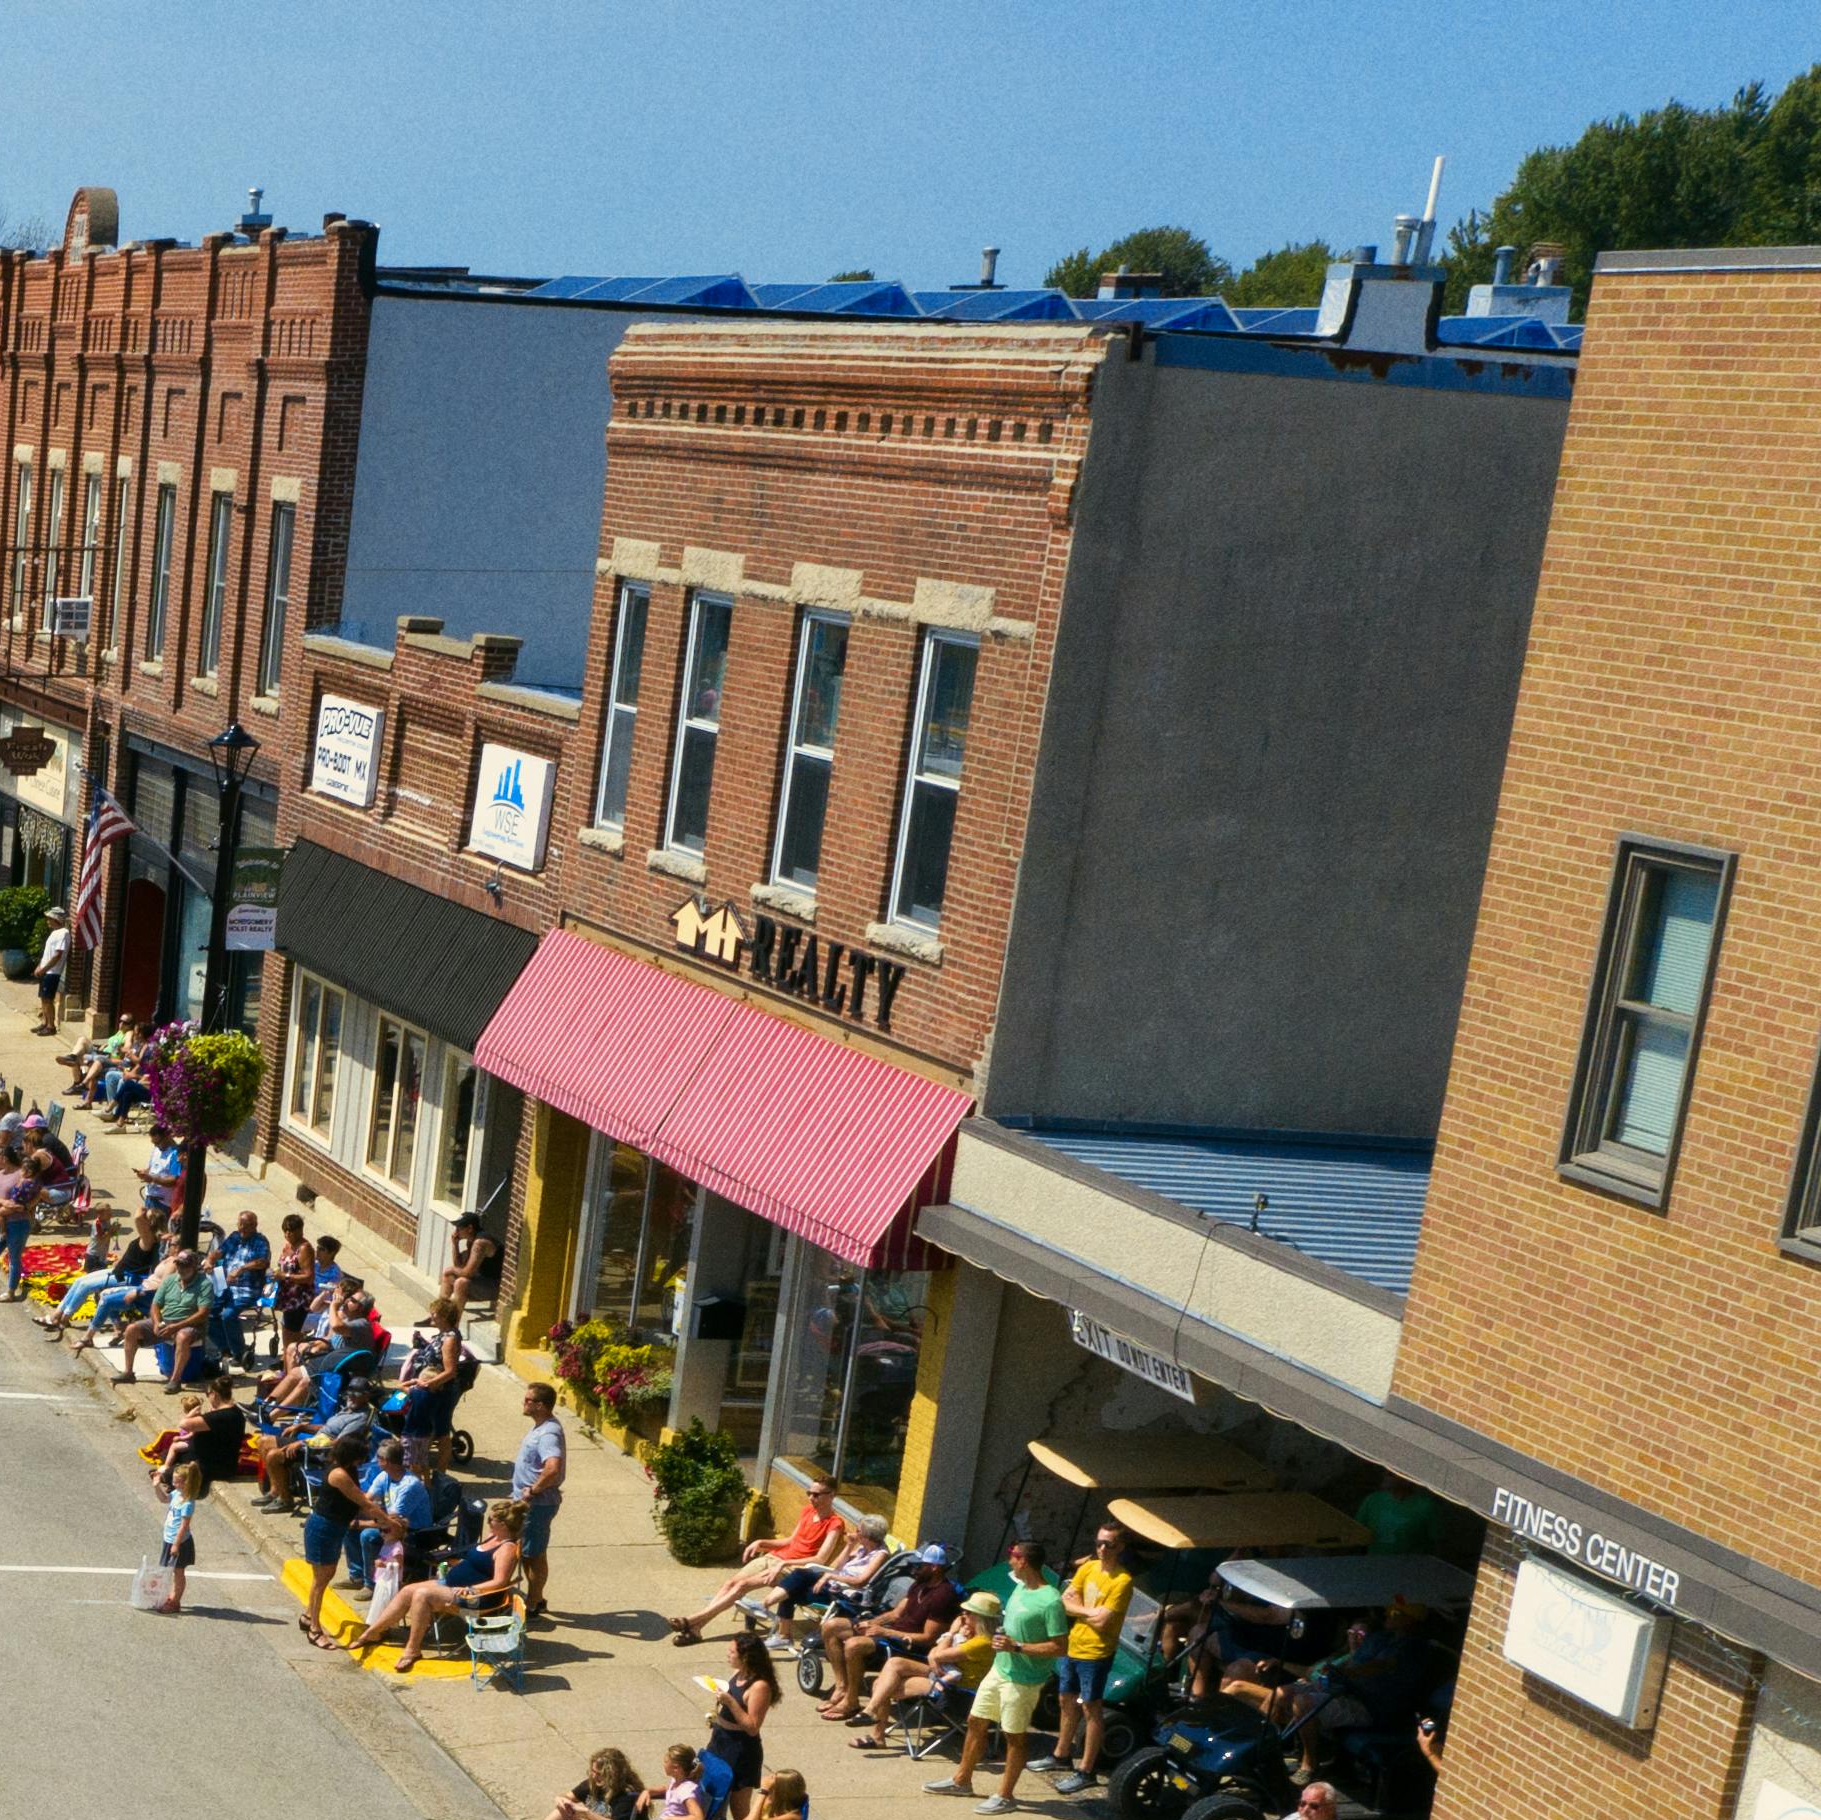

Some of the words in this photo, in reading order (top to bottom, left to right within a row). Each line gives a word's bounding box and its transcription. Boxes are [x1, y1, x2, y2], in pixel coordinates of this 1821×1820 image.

[319, 706, 373, 740] PRO-VUE
[354, 760, 367, 781] MX
[495, 809, 520, 836] WSE
[751, 915, 905, 1033] REALTY
[1492, 1486, 1583, 1556] FITNESS
[1586, 1533, 1679, 1606] CENTER
